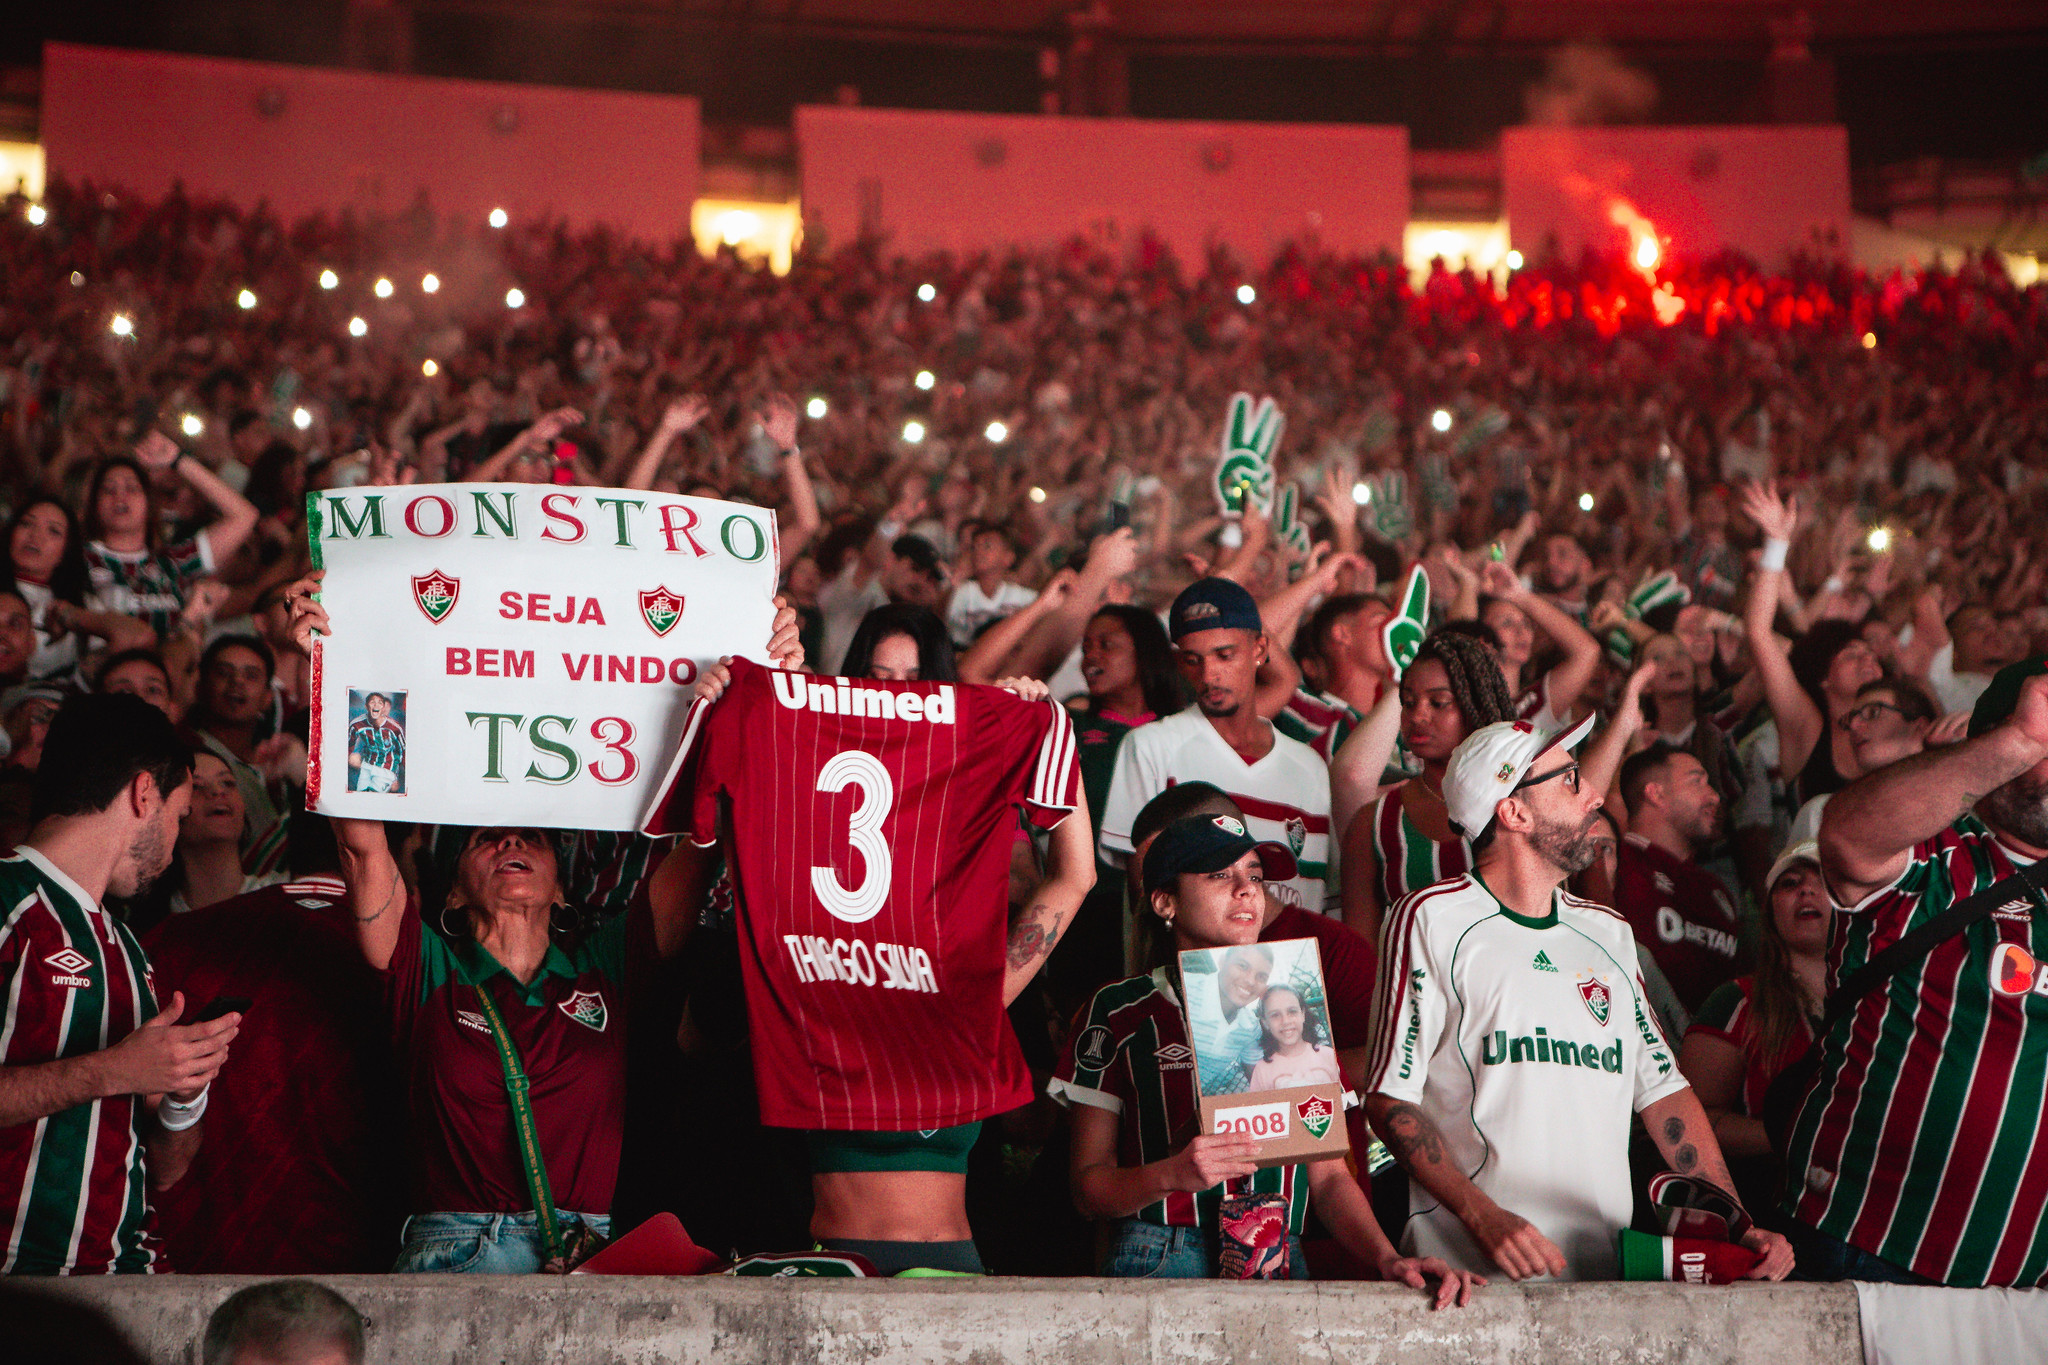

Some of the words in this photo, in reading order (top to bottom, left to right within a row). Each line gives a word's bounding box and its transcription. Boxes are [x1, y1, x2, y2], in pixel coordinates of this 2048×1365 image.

[326, 491, 770, 563] MONSTRO
[498, 591, 607, 626] SEJA
[446, 647, 536, 678] BEM
[561, 652, 698, 685] VINDO
[772, 672, 955, 724] Unimed
[465, 711, 641, 787] TS3
[810, 749, 894, 923] 3
[1991, 911, 2032, 921] umbro
[1684, 921, 1738, 957] BETAN
[51, 974, 91, 988] umbro
[783, 935, 876, 987] THIAGO
[875, 942, 940, 993] SILVA
[1532, 963, 1559, 973] adidas
[458, 1017, 493, 1035] umbro
[1159, 1061, 1194, 1071] umbro
[1482, 1026, 1623, 1074] Unimed
[1216, 1112, 1286, 1136] 2008
